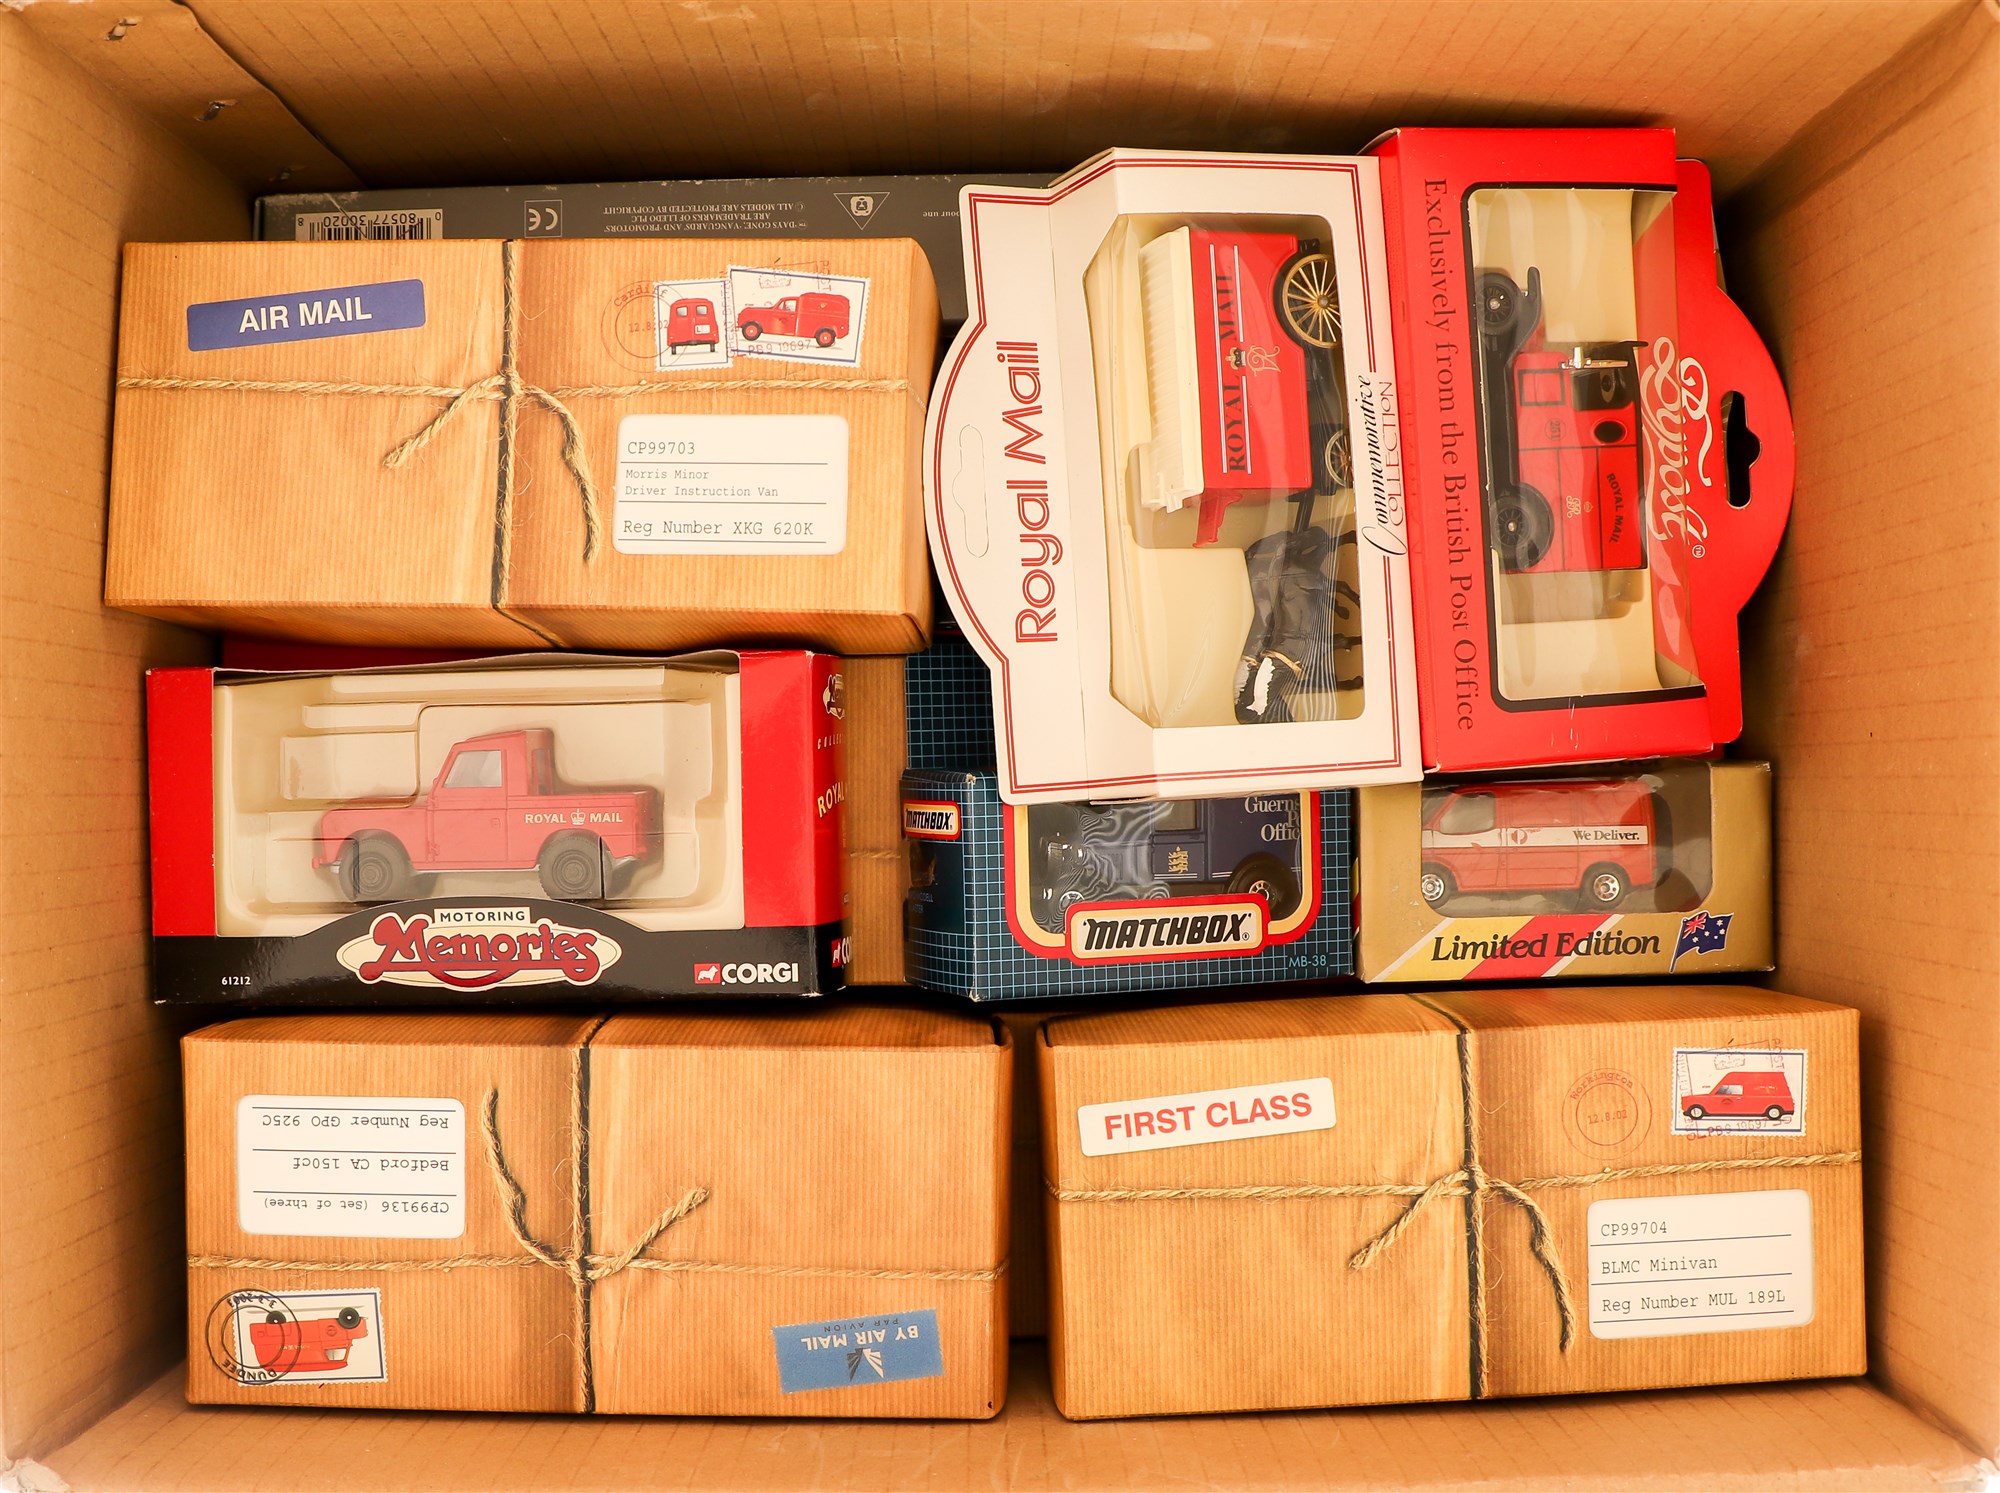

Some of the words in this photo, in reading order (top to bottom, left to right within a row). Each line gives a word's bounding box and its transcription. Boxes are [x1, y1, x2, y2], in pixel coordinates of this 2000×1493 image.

[603, 206, 654, 214] COPYRIGHT
[655, 205, 667, 213] BY
[669, 205, 720, 213] PROTECTED
[721, 204, 739, 212] ARE
[740, 203, 775, 211] MODELS
[777, 203, 794, 211] ALL
[298, 217, 304, 226] 8
[323, 215, 367, 227] 30020
[373, 213, 417, 225] 80577
[435, 212, 442, 221] 0
[632, 215, 648, 223] PLC
[679, 214, 691, 222] OF
[692, 213, 752, 221] TRADEMARKS
[1424, 178, 1457, 334] Exclusively
[613, 284, 668, 308] Cardiff
[1216, 265, 1238, 341] MAIL
[239, 305, 289, 333] AIR
[298, 296, 373, 327] MAIL
[1435, 341, 1458, 413] from
[996, 340, 1046, 464] Mail
[1223, 375, 1247, 472] ROYAL
[627, 441, 696, 455] CP99703
[1441, 424, 1464, 465] the
[1378, 381, 1404, 527] COLLECTION
[1355, 375, 1408, 556] Commemorative
[625, 469, 668, 479] Morris
[674, 469, 710, 480] Minor
[625, 486, 667, 496] Driver
[674, 486, 751, 497] Instruction
[758, 487, 779, 497] Van
[1606, 472, 1624, 513] ROYAL
[1444, 473, 1473, 565] British
[623, 521, 653, 537] Reg
[663, 520, 723, 535] Number
[733, 522, 763, 535] XKG
[774, 522, 814, 536] 620K
[1608, 514, 1624, 544] MAIL
[1006, 480, 1063, 643] Royal
[1451, 574, 1473, 631] Post
[1454, 638, 1479, 731] Office
[525, 813, 567, 823] ROYAL
[589, 812, 623, 823] MAIL
[1572, 830, 1592, 841] We
[1594, 829, 1640, 842] Deliver.
[439, 910, 526, 923] MOTORING
[359, 916, 600, 987] Memories
[1430, 933, 1547, 962] Limited
[1554, 929, 1661, 958] Edition
[1288, 954, 1328, 968] MB-38
[221, 975, 251, 986] 61212
[721, 962, 799, 985] CORGI
[1569, 1071, 1634, 1101] Workington
[262, 1115, 300, 1128] 925C
[311, 1115, 341, 1128] GPO
[350, 1115, 410, 1128] Number
[420, 1115, 449, 1129] Reg
[1105, 1106, 1196, 1140] FIRST
[1206, 1092, 1313, 1128] CLASS
[293, 1157, 340, 1170] 150cf
[350, 1158, 370, 1170] CA
[380, 1158, 450, 1171] Bedford
[264, 1198, 308, 1209] three)
[316, 1199, 332, 1210] of
[341, 1199, 368, 1210] (Set
[381, 1201, 450, 1214] CP99136
[1600, 1221, 1668, 1237] CP99704
[1602, 1260, 1641, 1275] BLMC
[1650, 1256, 1718, 1272] Minivan
[1602, 1299, 1631, 1314] Reg
[1641, 1294, 1699, 1310] Number
[1708, 1292, 1738, 1307] MUL
[1748, 1289, 1786, 1305] 189L
[824, 1321, 865, 1333] AVION
[874, 1318, 899, 1327] PAR
[855, 1328, 886, 1345] AIR
[895, 1325, 919, 1341] BY
[801, 1333, 848, 1351] MAIL
[222, 1359, 278, 1381] DUNDEE
